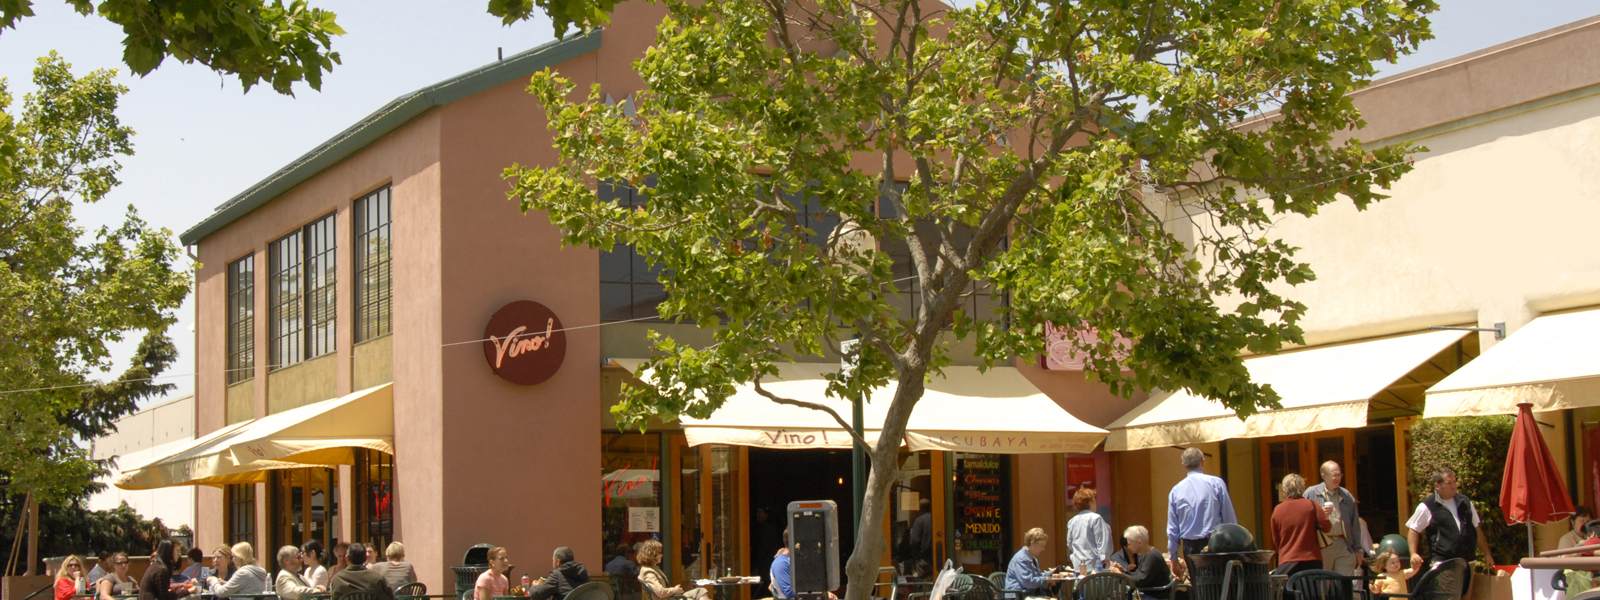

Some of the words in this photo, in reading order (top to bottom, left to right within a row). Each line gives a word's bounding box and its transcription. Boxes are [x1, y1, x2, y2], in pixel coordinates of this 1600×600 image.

[490, 317, 554, 368] Vino!
[764, 428, 829, 445] Vino!
[965, 522, 1001, 535] MENUDO
